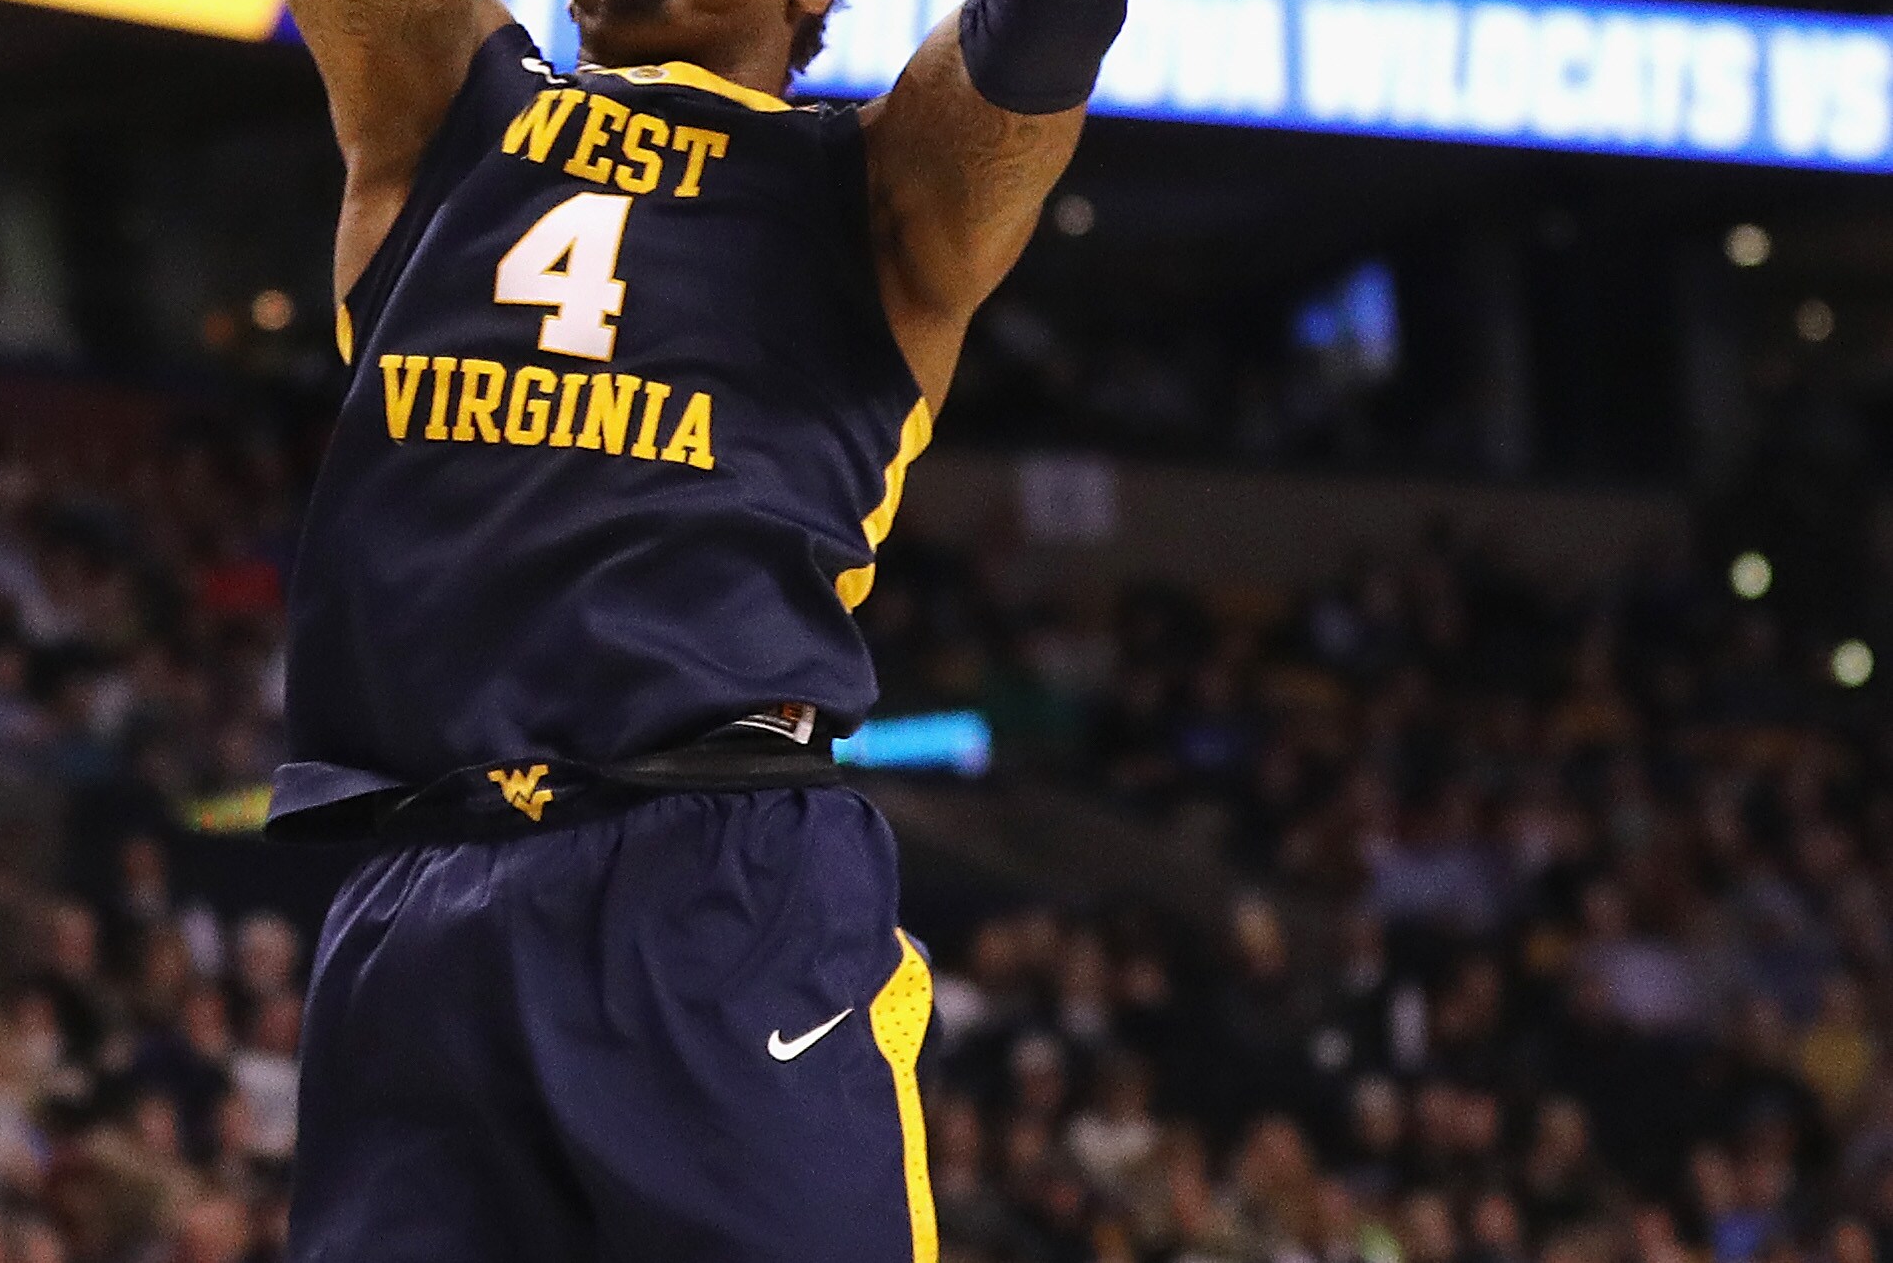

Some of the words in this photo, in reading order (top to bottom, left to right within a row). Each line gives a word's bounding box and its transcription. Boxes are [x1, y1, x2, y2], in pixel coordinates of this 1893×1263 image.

[501, 87, 730, 198] WEST
[1768, 26, 1893, 162] VS
[493, 191, 634, 362] 4
[378, 353, 715, 470] VIRGINIA
